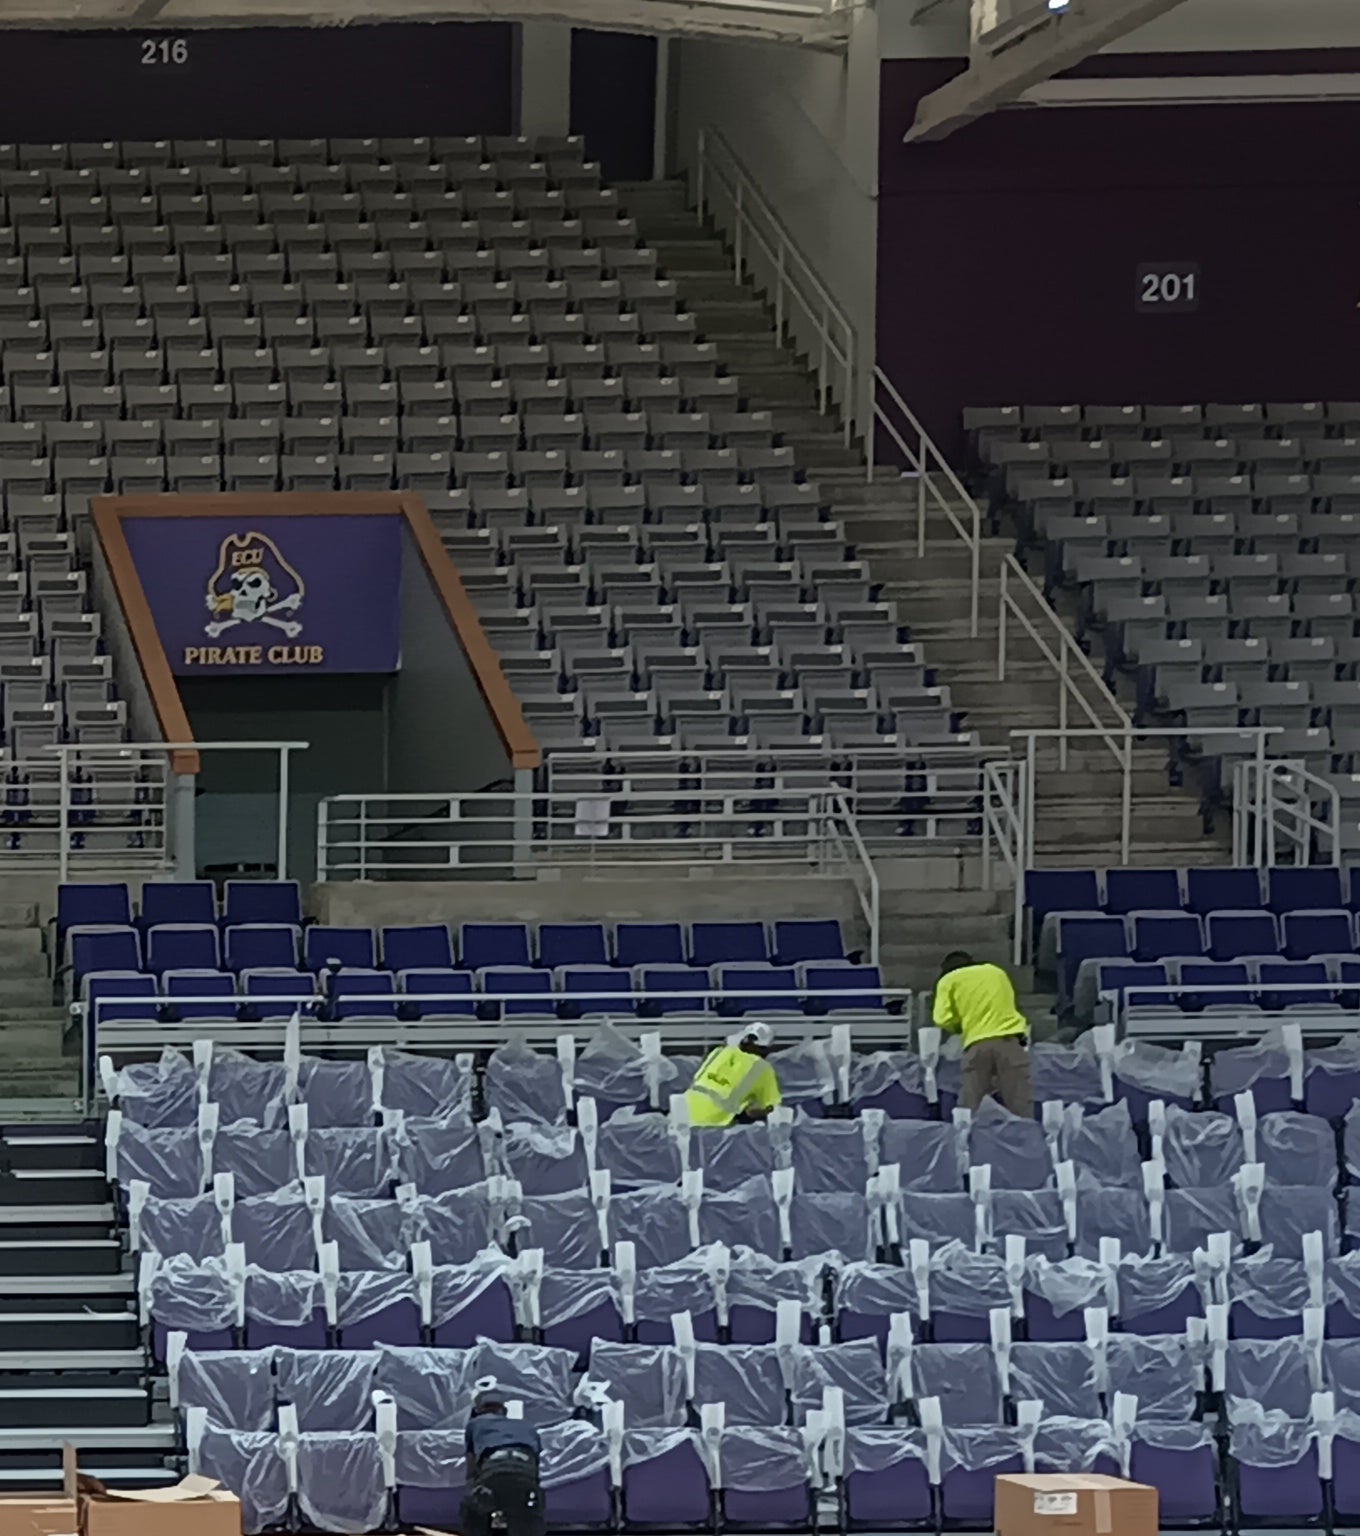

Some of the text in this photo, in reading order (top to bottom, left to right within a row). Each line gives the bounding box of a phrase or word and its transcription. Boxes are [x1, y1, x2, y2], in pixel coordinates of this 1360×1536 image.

[141, 39, 188, 64] 216
[1141, 273, 1195, 302] 201
[232, 547, 264, 566] ECU
[184, 645, 324, 665] PIRATE CLUB
